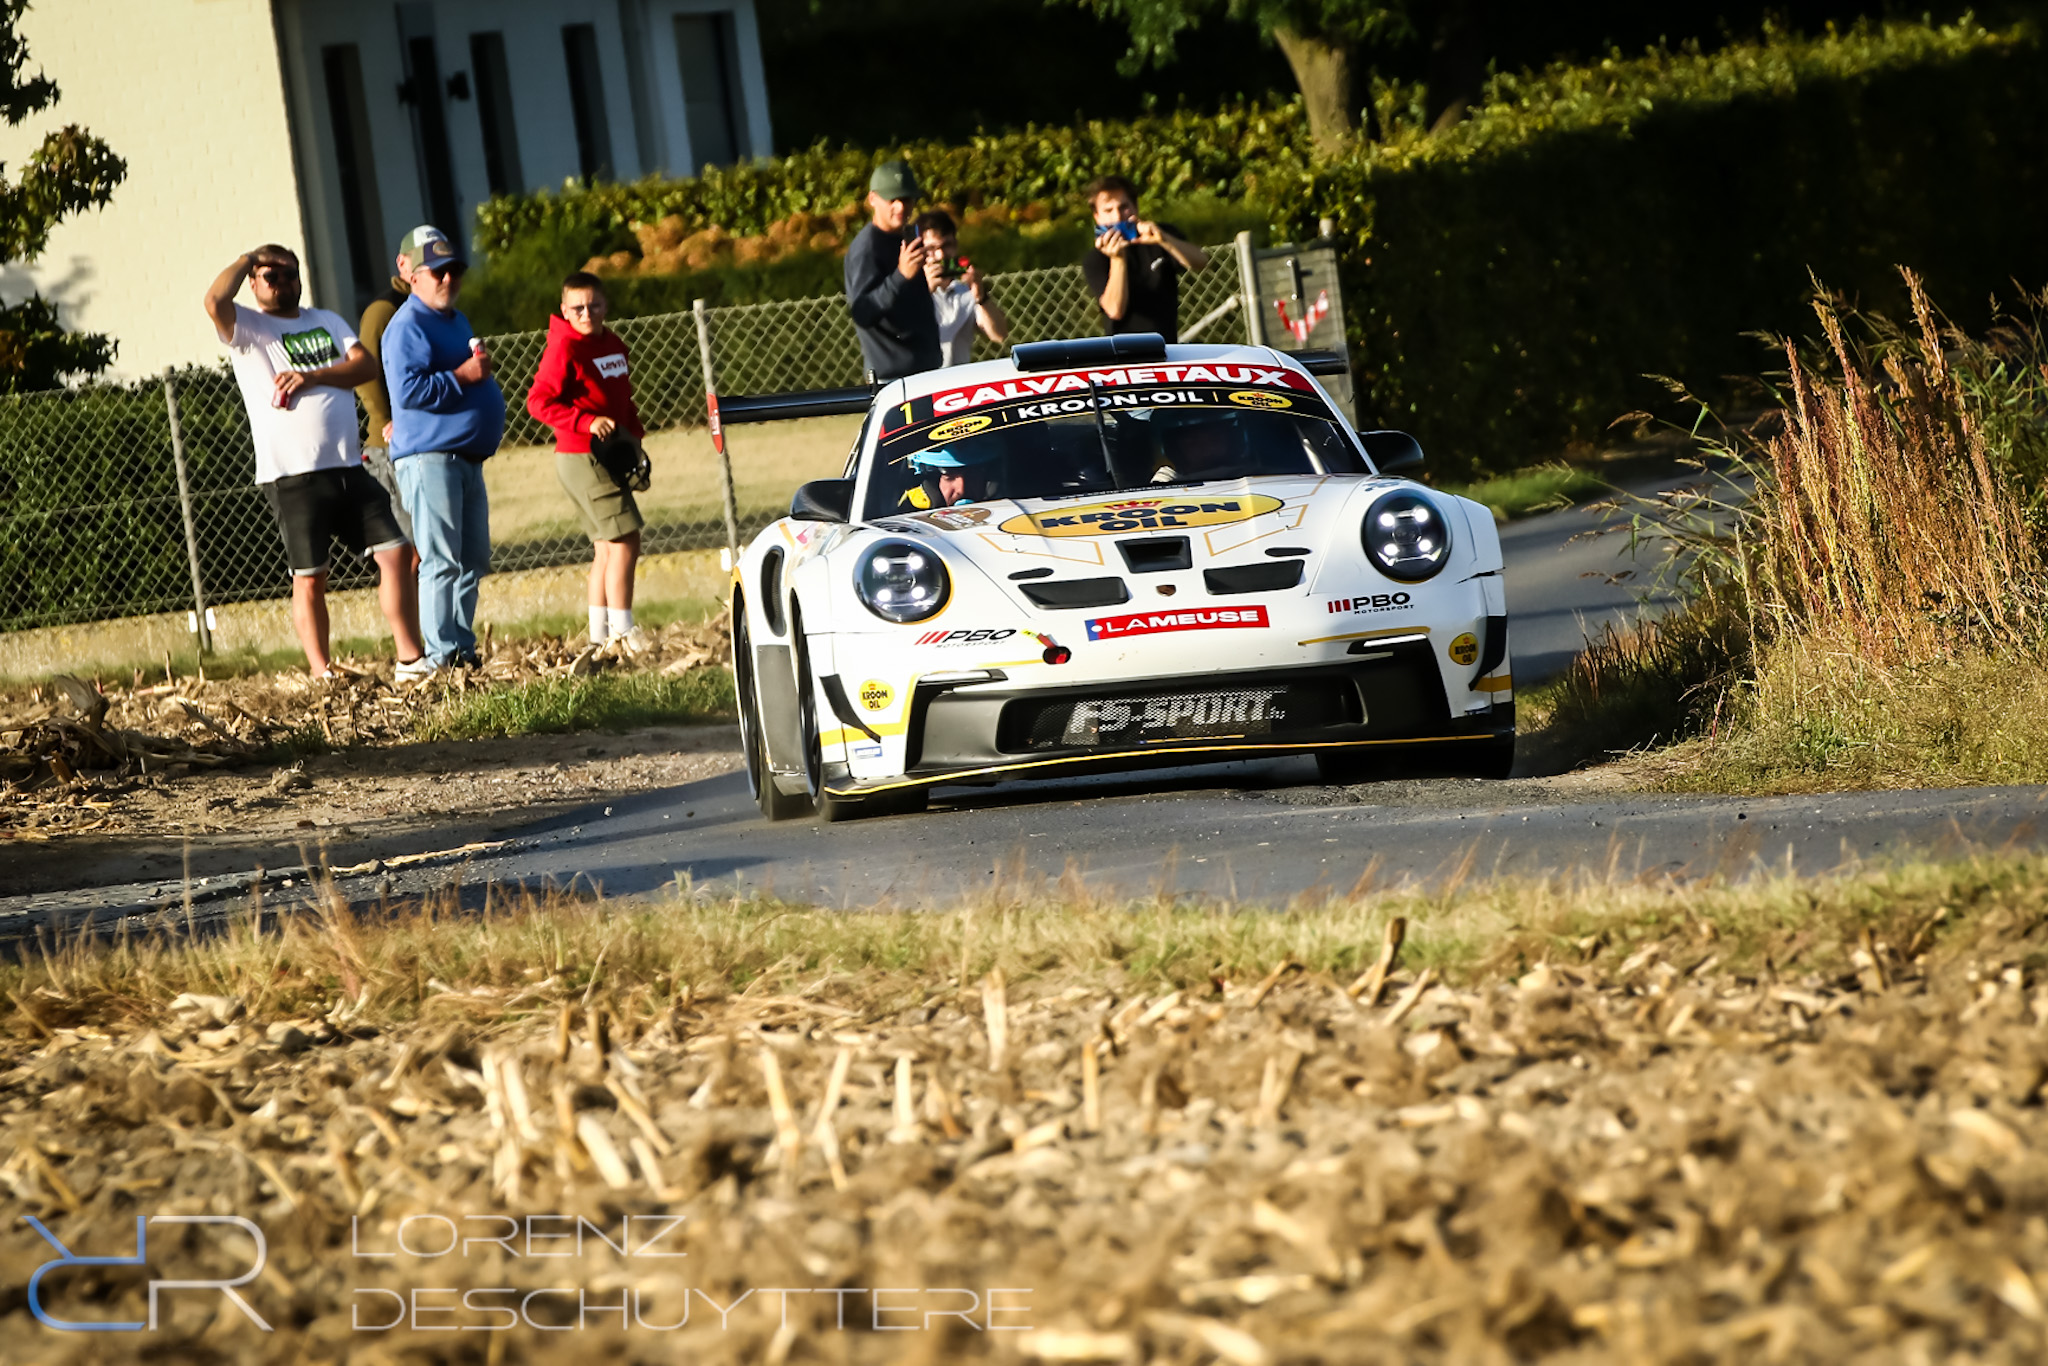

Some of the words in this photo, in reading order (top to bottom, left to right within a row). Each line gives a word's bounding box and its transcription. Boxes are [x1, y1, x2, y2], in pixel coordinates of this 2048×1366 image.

[933, 366, 1291, 412] GALVAMETAUX
[1017, 390, 1204, 419] KROON-OIL
[899, 402, 913, 425] 1
[936, 420, 983, 436] KROON
[1040, 502, 1241, 529] KROON
[1099, 516, 1188, 531] OIL
[1352, 592, 1410, 609] PBO
[1354, 604, 1415, 614] MOTORSPORT
[942, 629, 1017, 643] PBO
